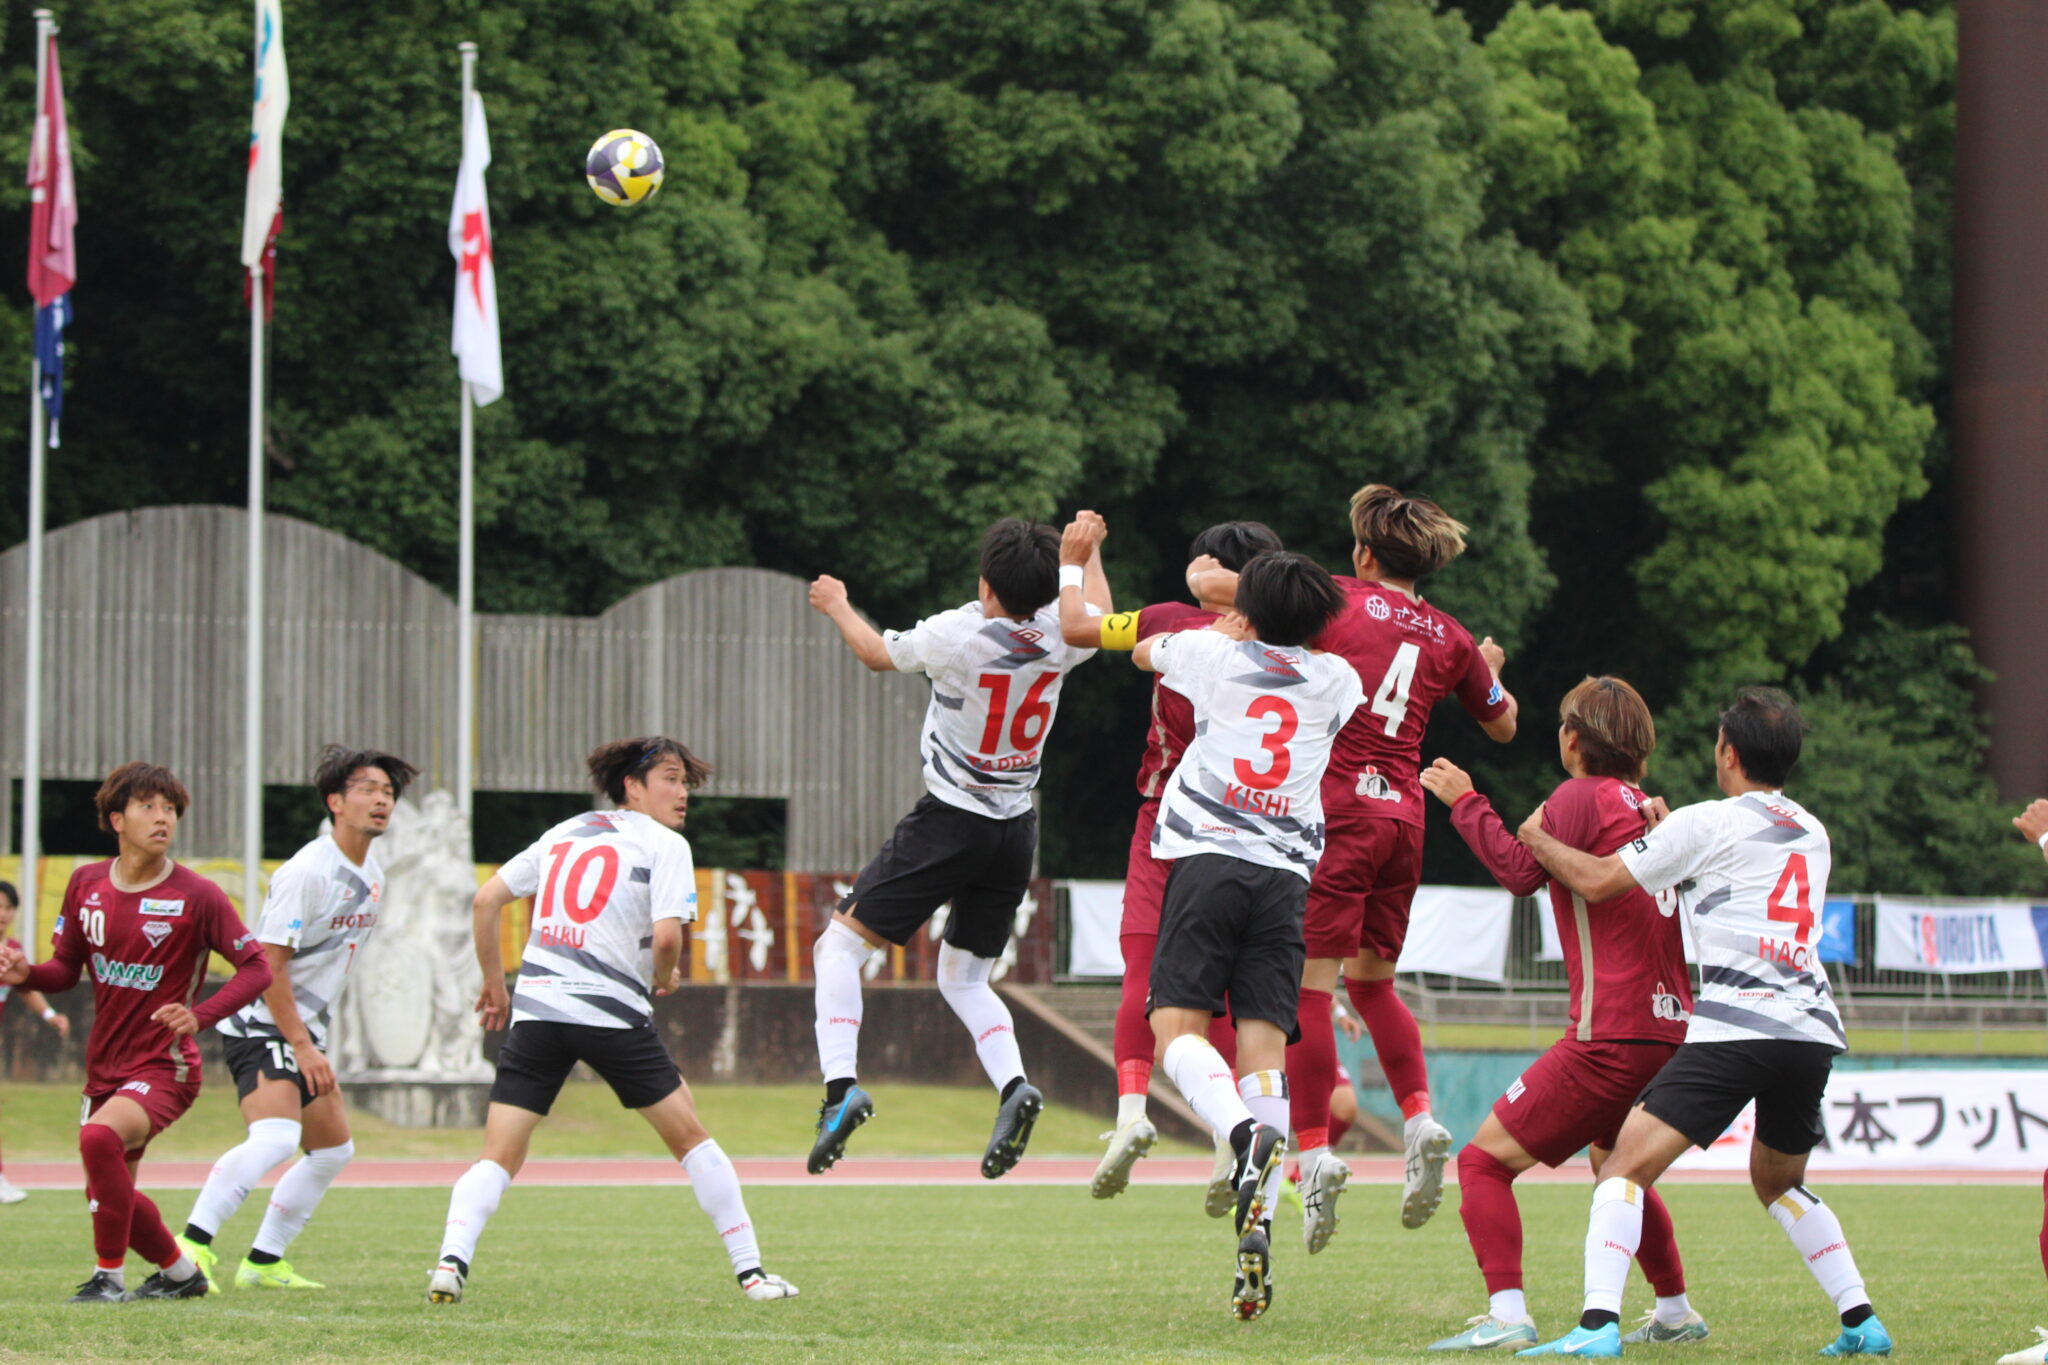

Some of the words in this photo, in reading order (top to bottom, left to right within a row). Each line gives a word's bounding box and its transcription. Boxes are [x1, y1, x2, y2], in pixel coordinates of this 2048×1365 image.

[979, 671, 1060, 755] 16
[1371, 641, 1420, 738] 4
[1233, 695, 1298, 790] 3
[1222, 782, 1292, 817] KISHI
[540, 841, 619, 924] 10
[1767, 852, 1814, 944] 4
[79, 907, 105, 947] 20
[540, 925, 586, 949] RIKU
[1759, 936, 1814, 972] HAC
[1911, 913, 2004, 965] TSURUTA
[265, 1041, 298, 1073] 15
[1816, 1092, 2048, 1153] 本フット
